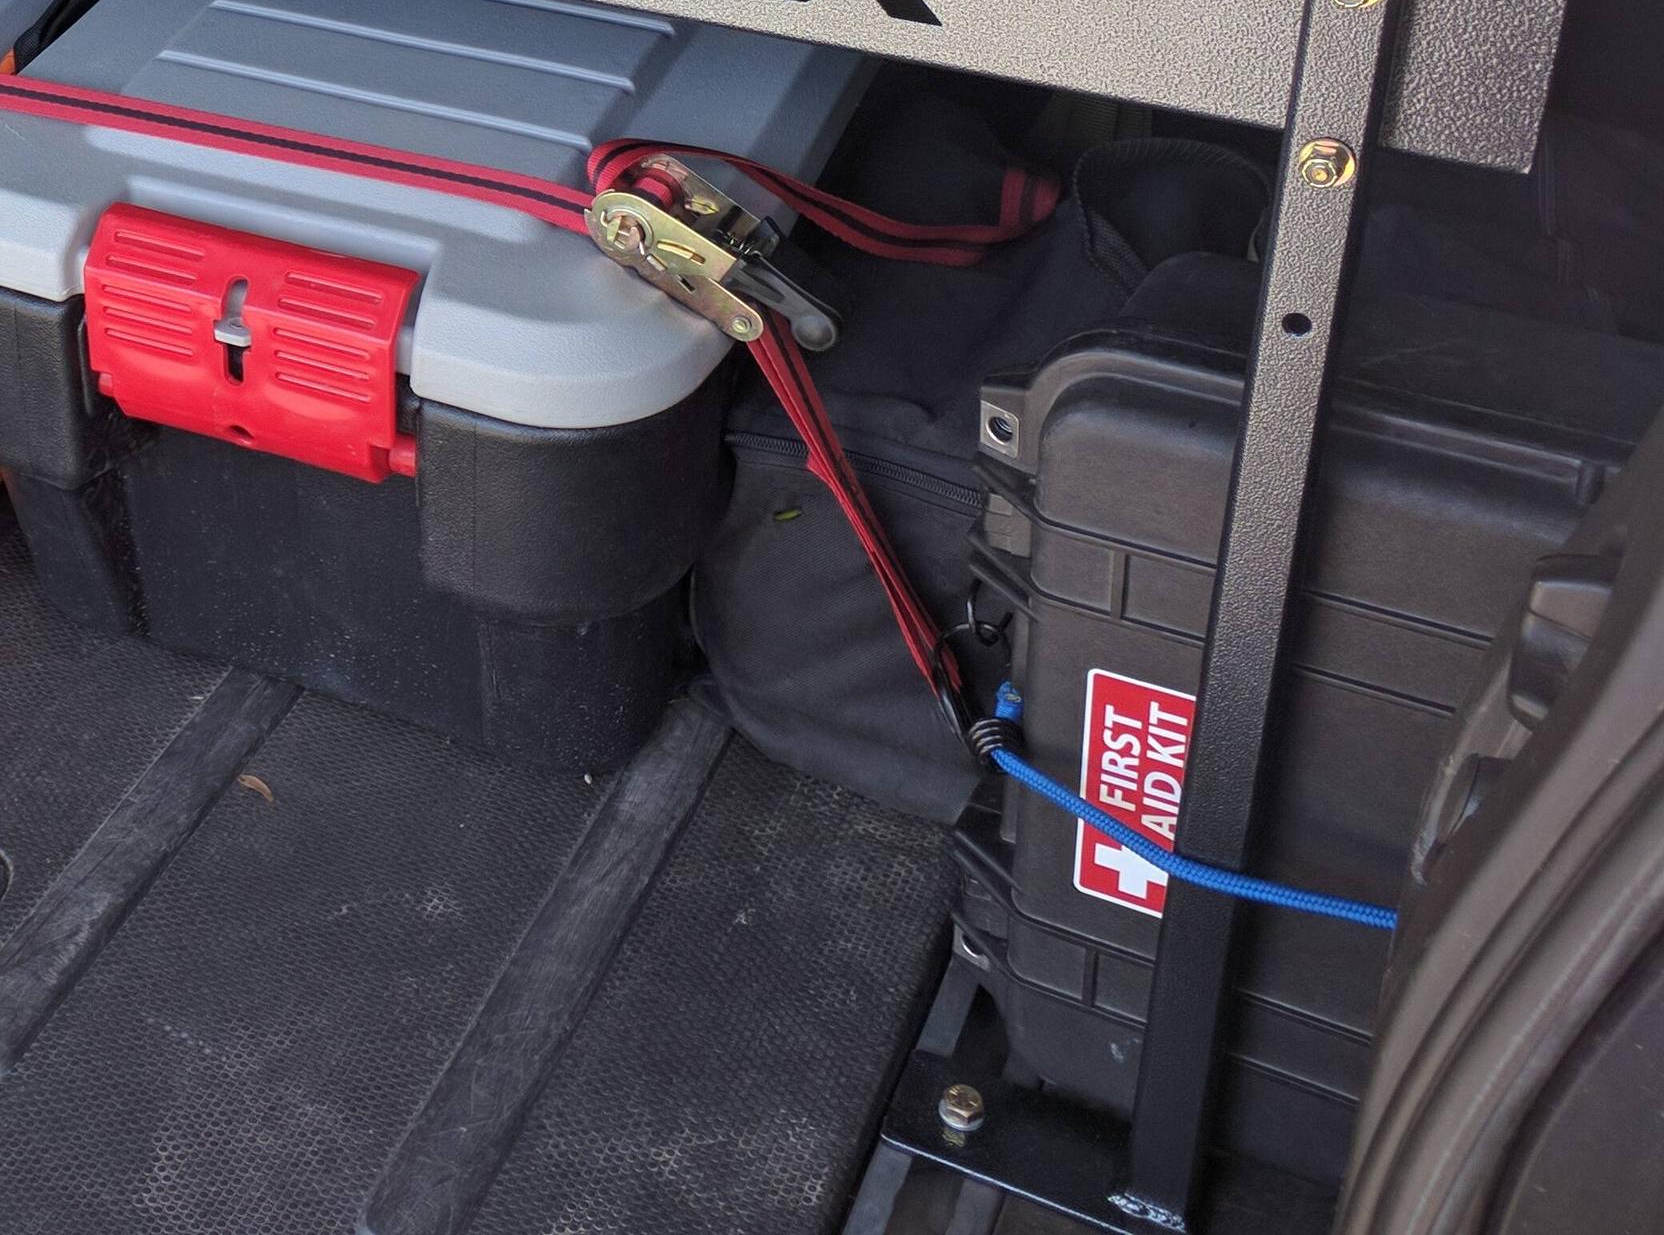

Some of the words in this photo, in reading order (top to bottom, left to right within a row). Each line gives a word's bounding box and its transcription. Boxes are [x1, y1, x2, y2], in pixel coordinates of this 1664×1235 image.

[1099, 705, 1144, 811] FIRST
[1145, 701, 1189, 768] KIT
[1141, 771, 1182, 841] AID
